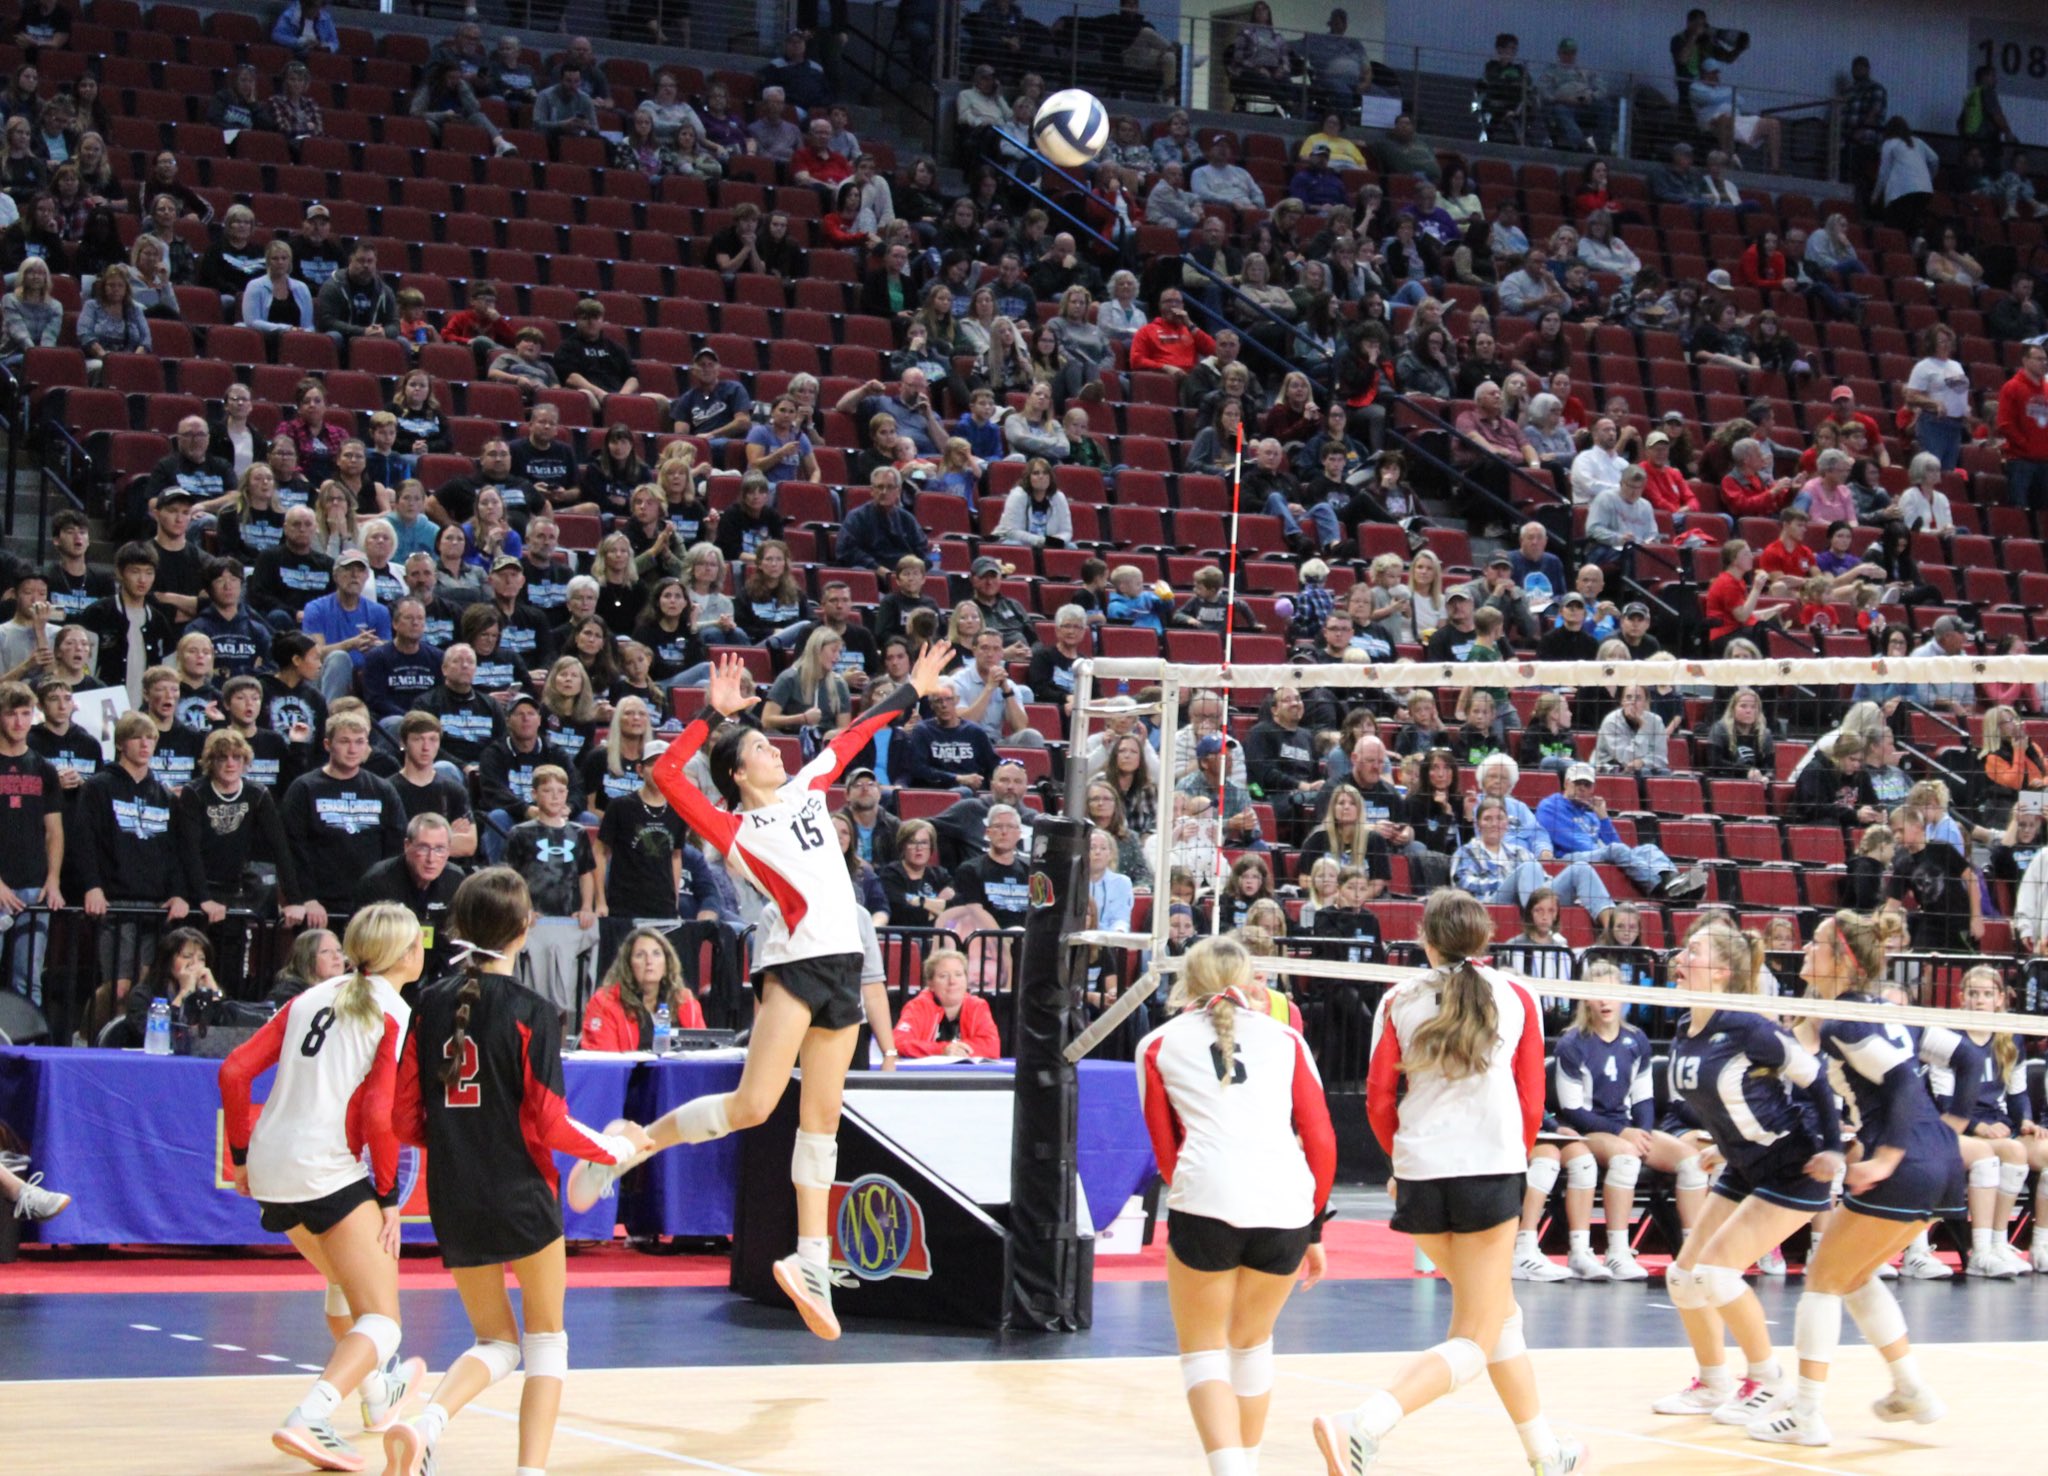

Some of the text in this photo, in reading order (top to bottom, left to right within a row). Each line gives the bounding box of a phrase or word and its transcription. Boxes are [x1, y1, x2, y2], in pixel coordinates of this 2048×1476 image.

[1978, 39, 2047, 79] 108
[211, 643, 256, 655] AGLES
[790, 812, 825, 851] 15
[300, 1006, 336, 1058] 8
[443, 1034, 481, 1108] 2
[1604, 1055, 1618, 1082] 4
[1676, 1055, 1702, 1090] 13
